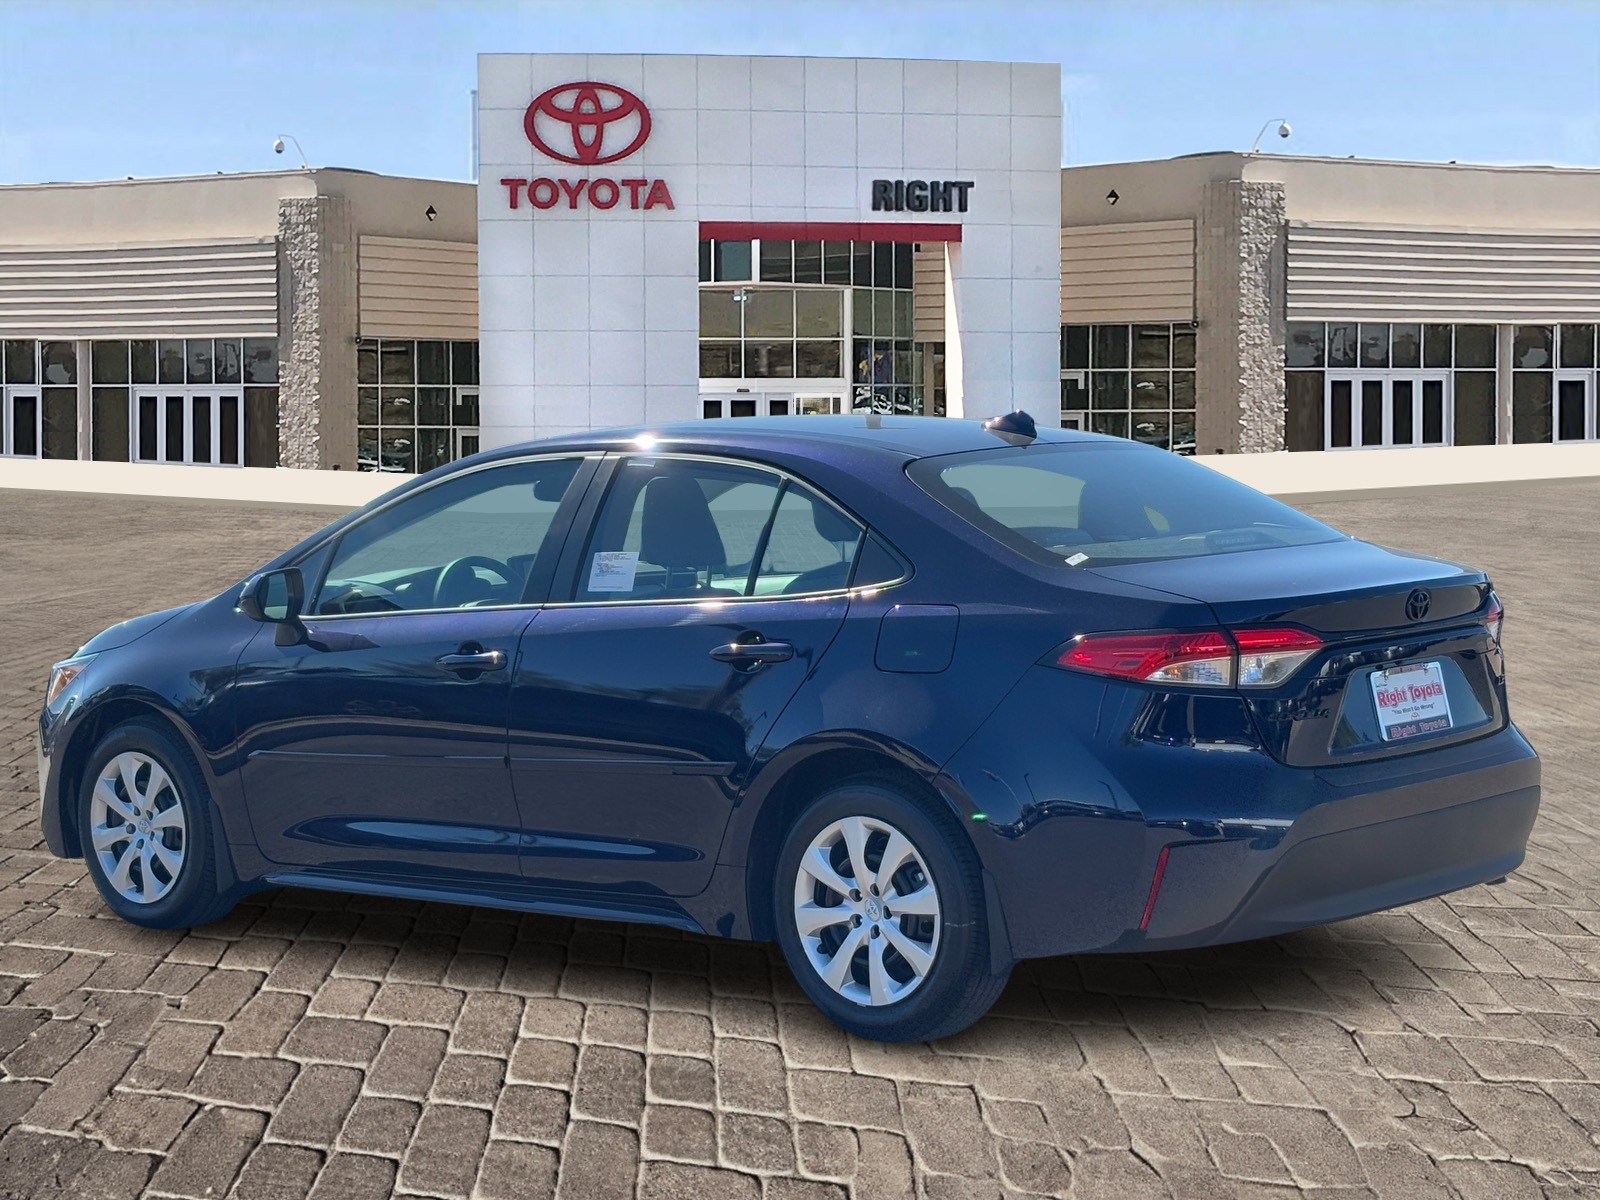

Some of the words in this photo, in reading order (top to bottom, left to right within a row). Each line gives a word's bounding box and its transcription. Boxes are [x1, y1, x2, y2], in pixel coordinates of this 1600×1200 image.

[500, 177, 675, 210] TOYOTA
[872, 179, 975, 212] RIGHT
[1377, 688, 1407, 707] Right
[1408, 682, 1442, 702] Toyota
[1391, 725, 1416, 737] Right
[1420, 719, 1447, 731] Toyota
